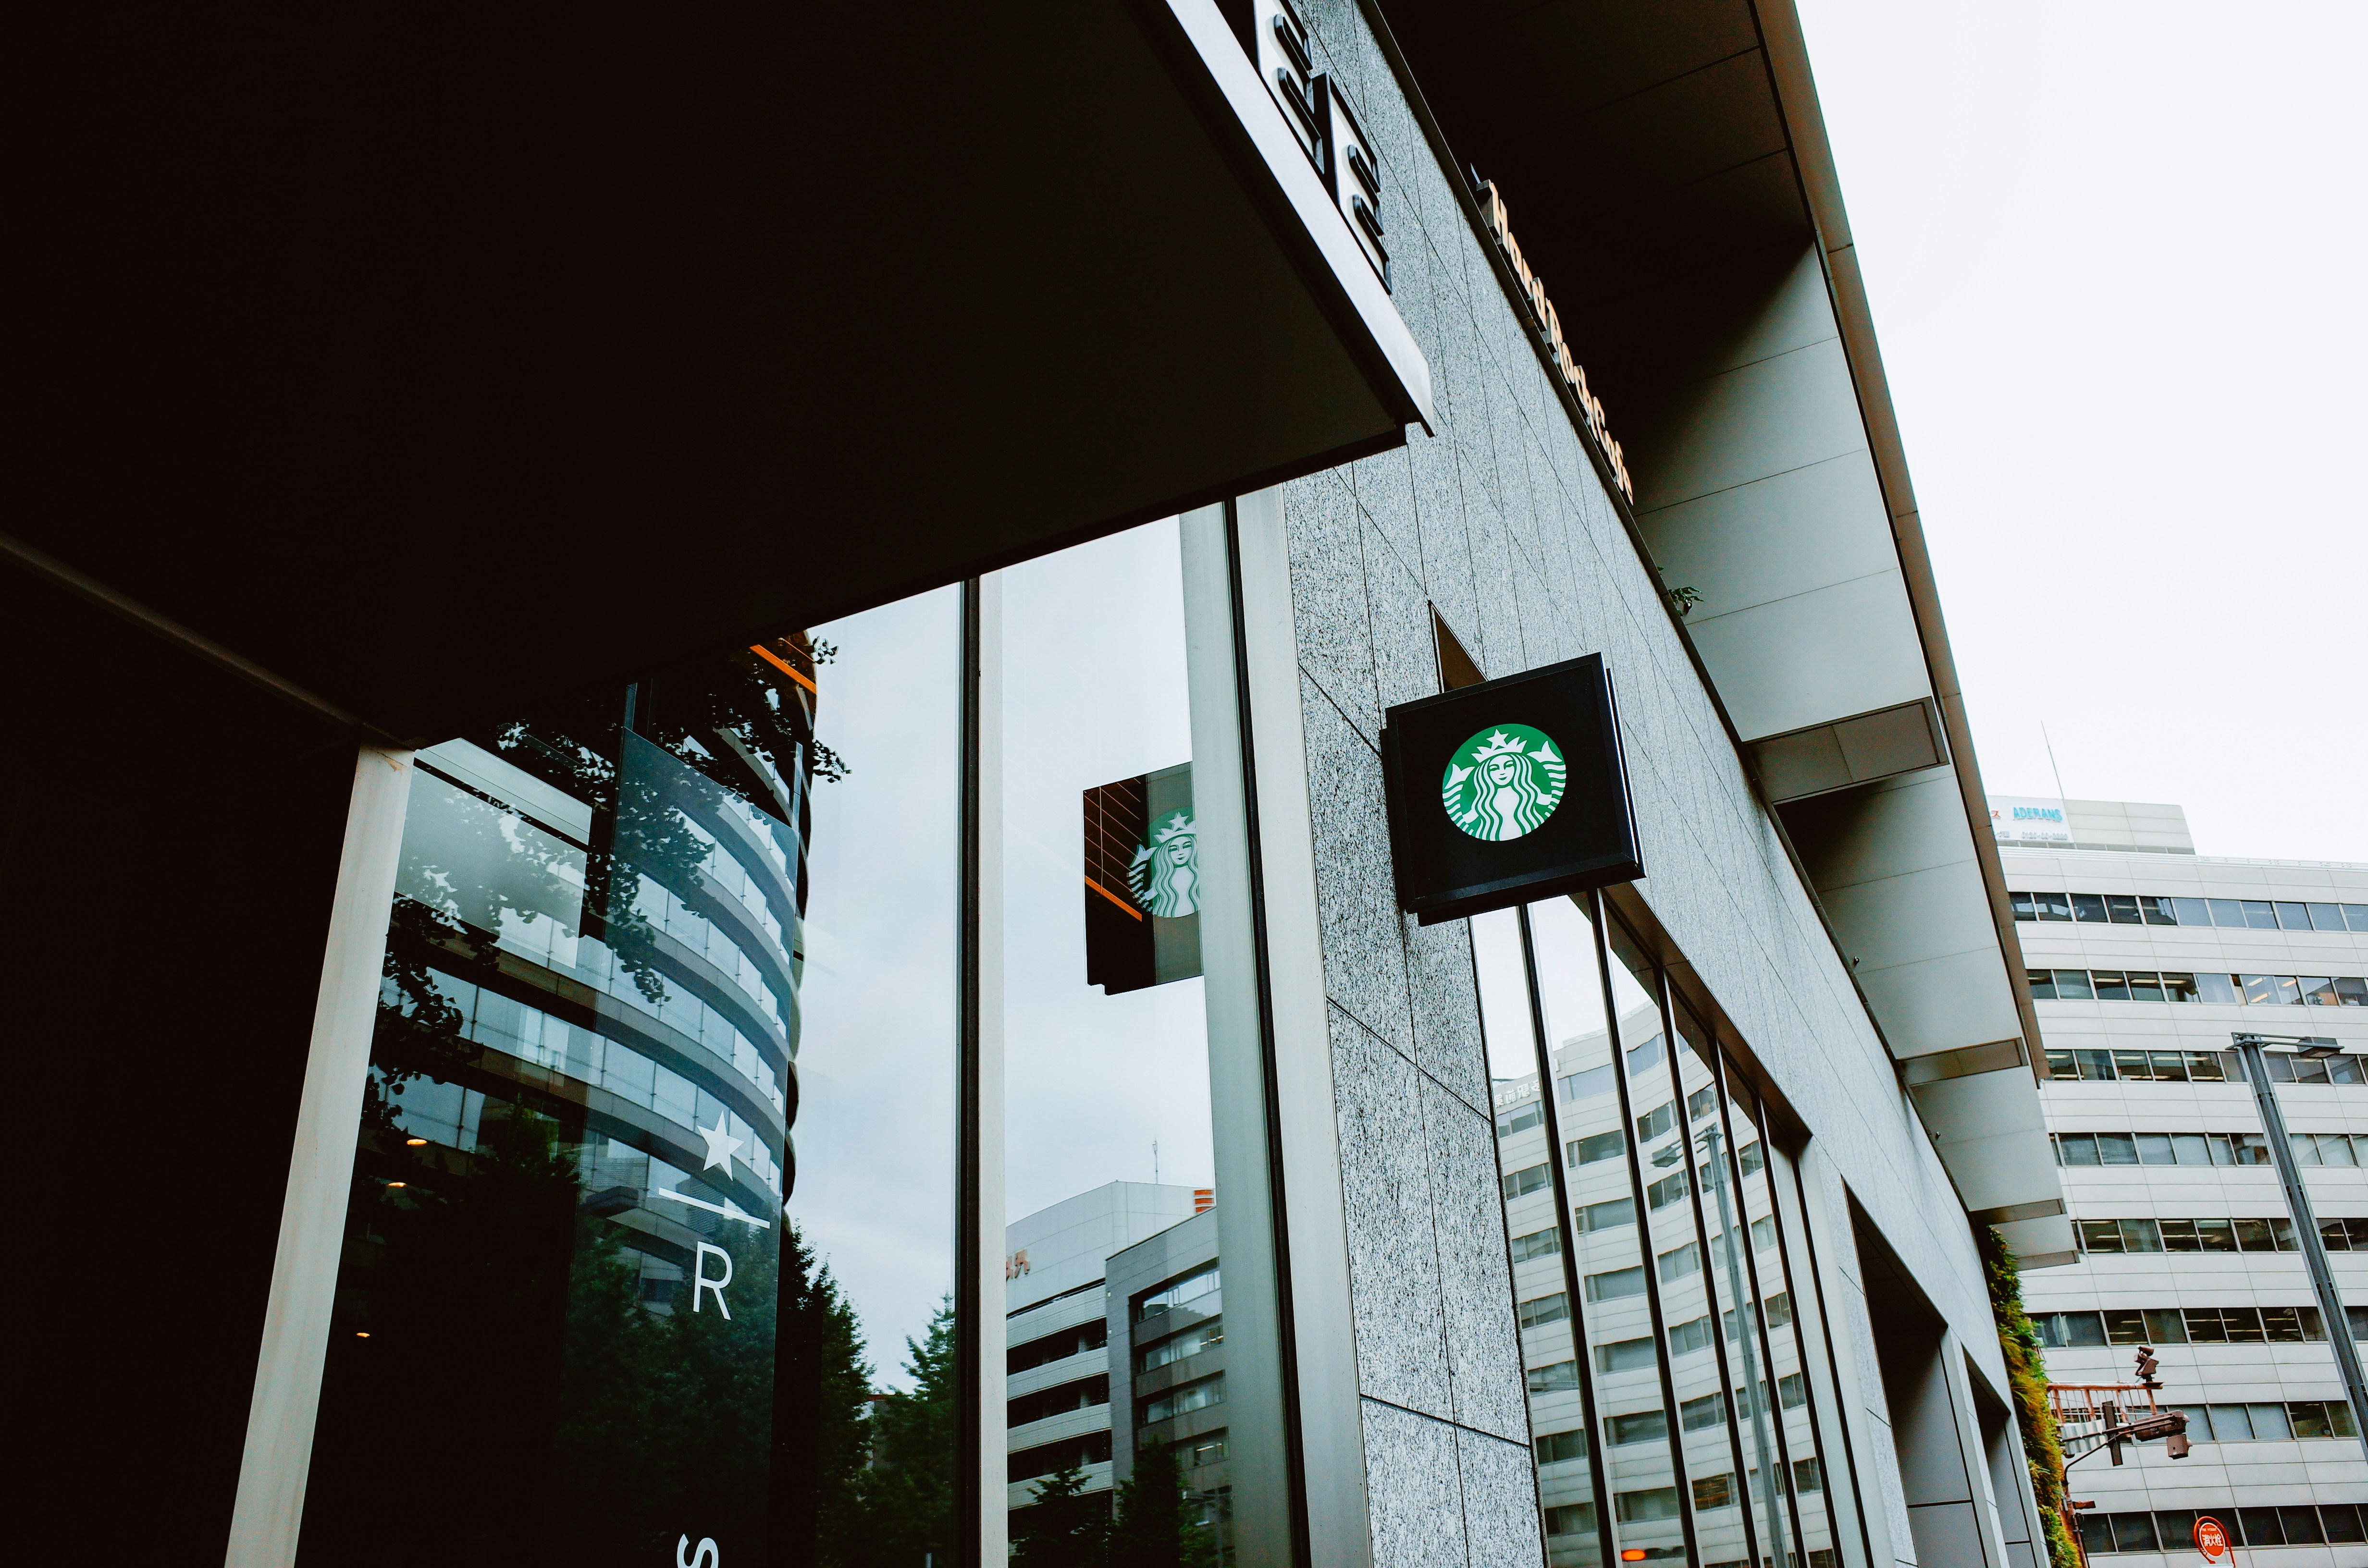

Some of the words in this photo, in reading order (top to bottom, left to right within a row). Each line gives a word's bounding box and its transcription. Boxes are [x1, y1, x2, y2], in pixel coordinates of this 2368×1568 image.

[1488, 179, 1546, 331] Hard
[1545, 297, 1600, 441] Rock
[1593, 395, 1634, 506] Cafe
[2013, 807, 2062, 822] ADERANS
[693, 1241, 732, 1321] R
[2201, 1533, 2223, 1546] 消火栓
